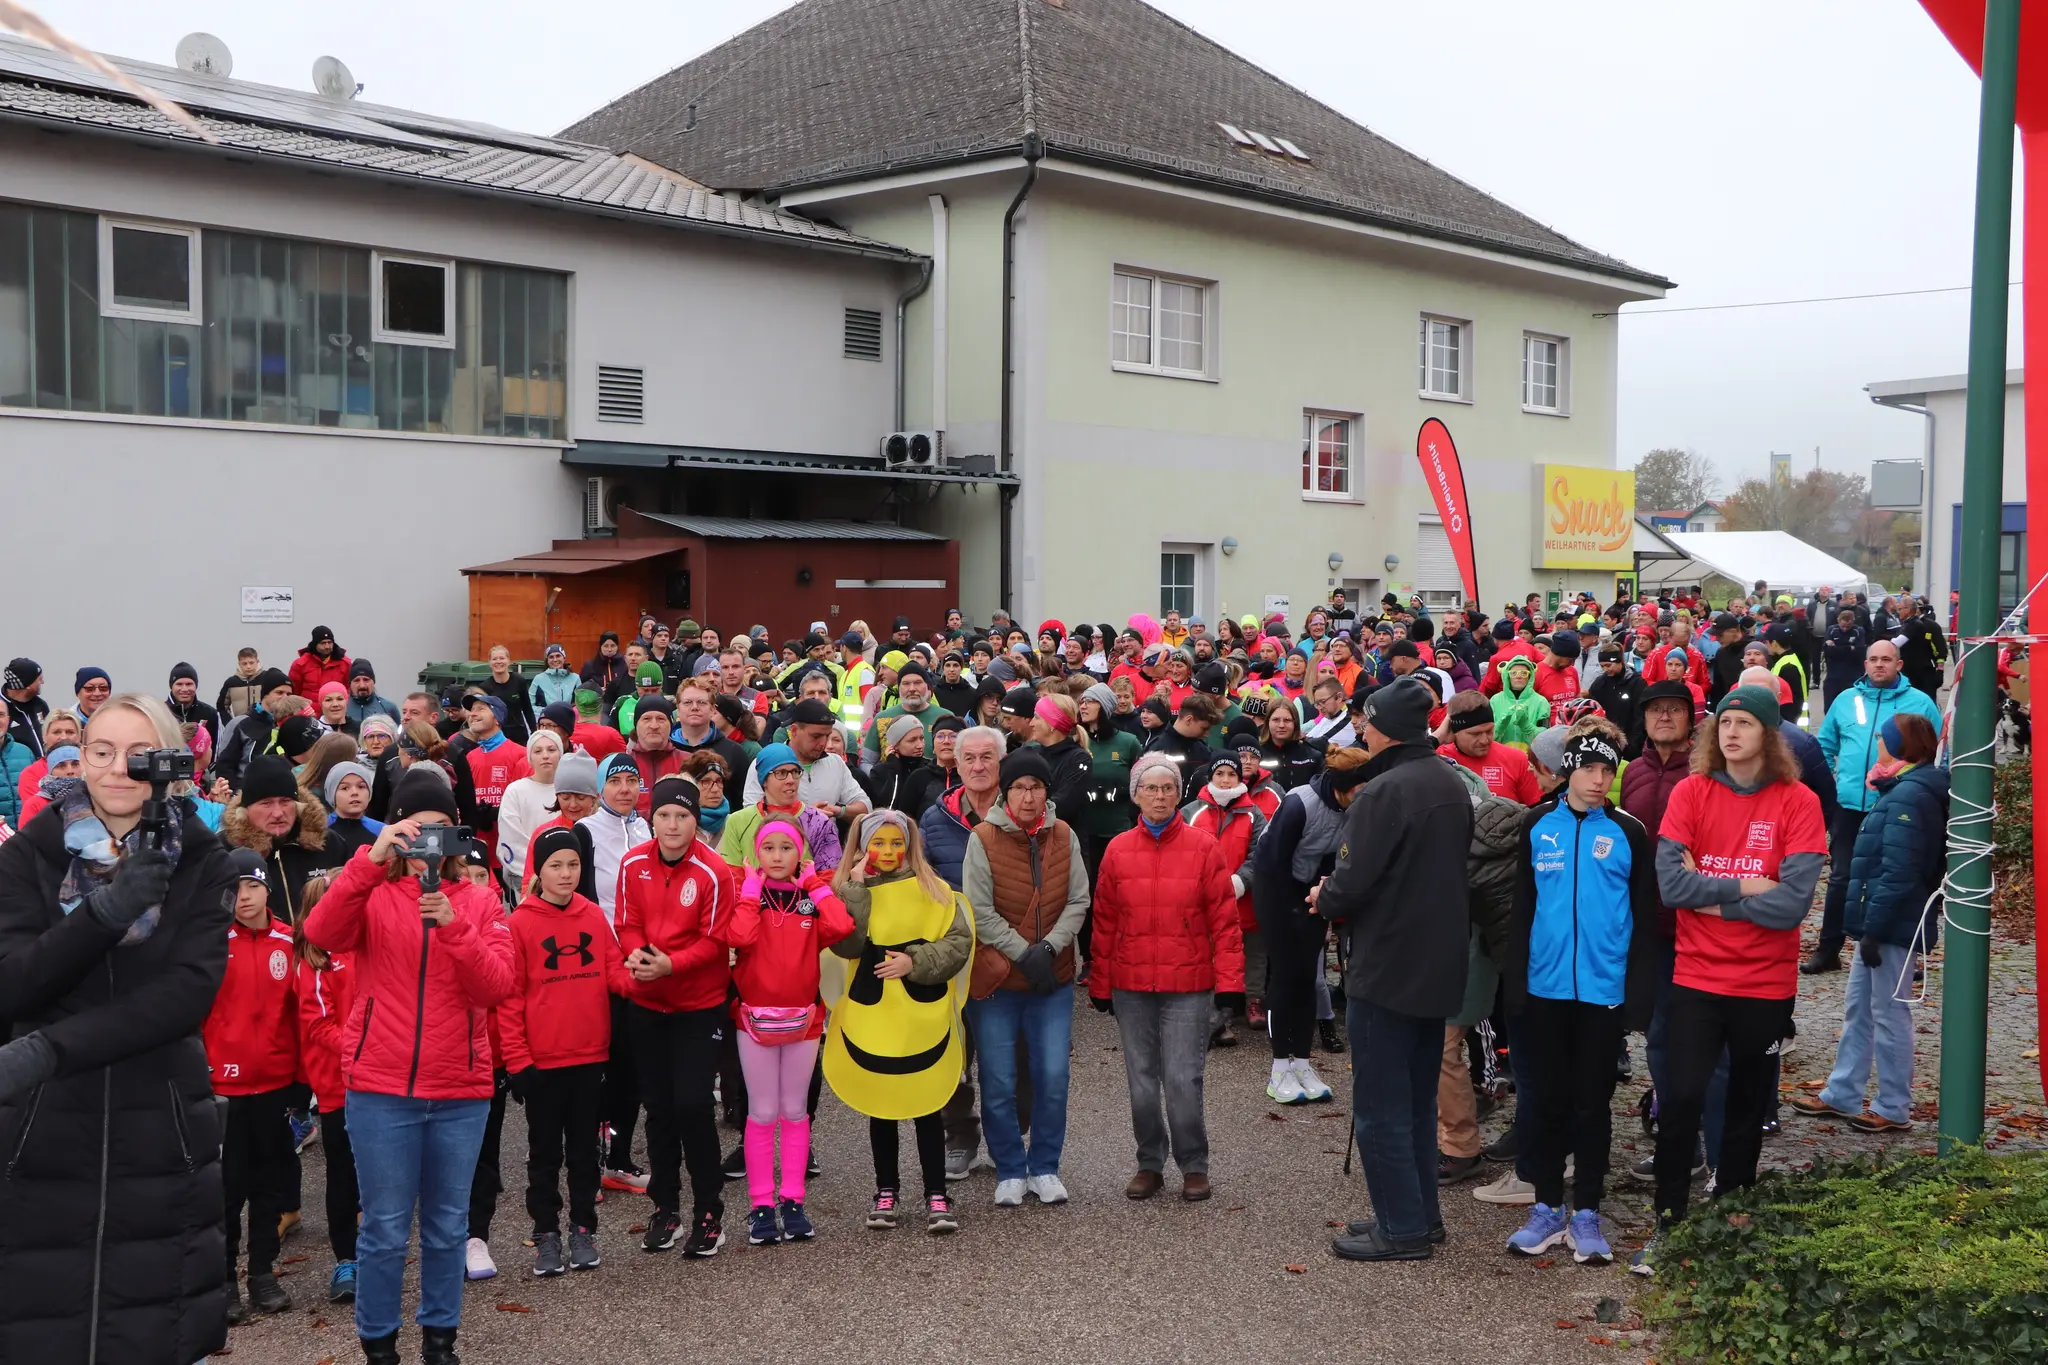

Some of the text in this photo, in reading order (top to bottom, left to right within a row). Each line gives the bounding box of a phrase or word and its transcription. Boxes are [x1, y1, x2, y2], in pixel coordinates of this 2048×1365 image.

[1551, 475, 1627, 537] Snack
[1545, 540, 1596, 551] WEILHARTNER
[608, 764, 639, 776] DYNA
[1700, 853, 1763, 871] #SEI FÜR
[569, 971, 601, 981] ARMOUR
[223, 1064, 240, 1077] 73
